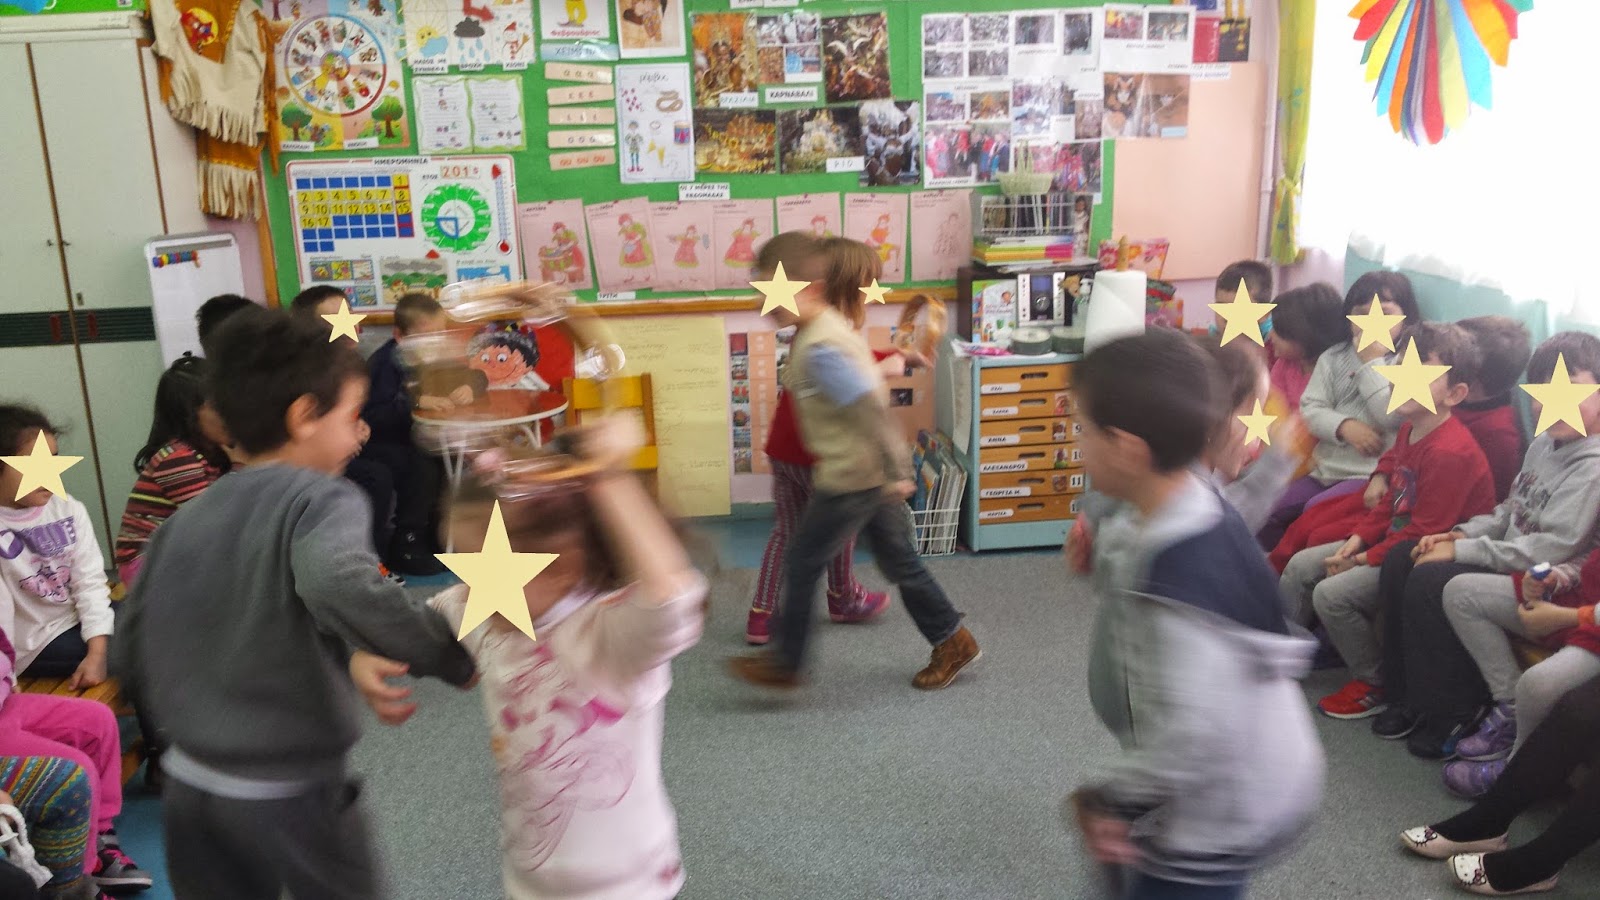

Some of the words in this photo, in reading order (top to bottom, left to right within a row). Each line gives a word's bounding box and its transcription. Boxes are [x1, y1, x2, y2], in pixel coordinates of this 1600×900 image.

[770, 90, 814, 98] ΚΑΡΝΑΒΑΛΙ
[834, 159, 854, 169] ΡΙΟ
[301, 192, 308, 203] 2
[316, 191, 324, 201] 3
[333, 190, 340, 200] 4
[349, 190, 356, 200] 5
[365, 190, 372, 200] 6
[380, 189, 388, 199] 7
[398, 189, 405, 200] 8
[302, 204, 309, 215] 9
[315, 204, 328, 214] 10
[333, 203, 343, 213] 11
[348, 204, 359, 214] 12
[364, 203, 376, 213] 13
[380, 203, 392, 213] 14
[398, 202, 410, 213] 15
[303, 218, 314, 228] 16
[317, 217, 329, 227] 17
[1075, 424, 1082, 433] 9
[983, 463, 1025, 471] ΑΛΕΞΑΝΔΡΟΣ
[1072, 476, 1081, 486] 11
